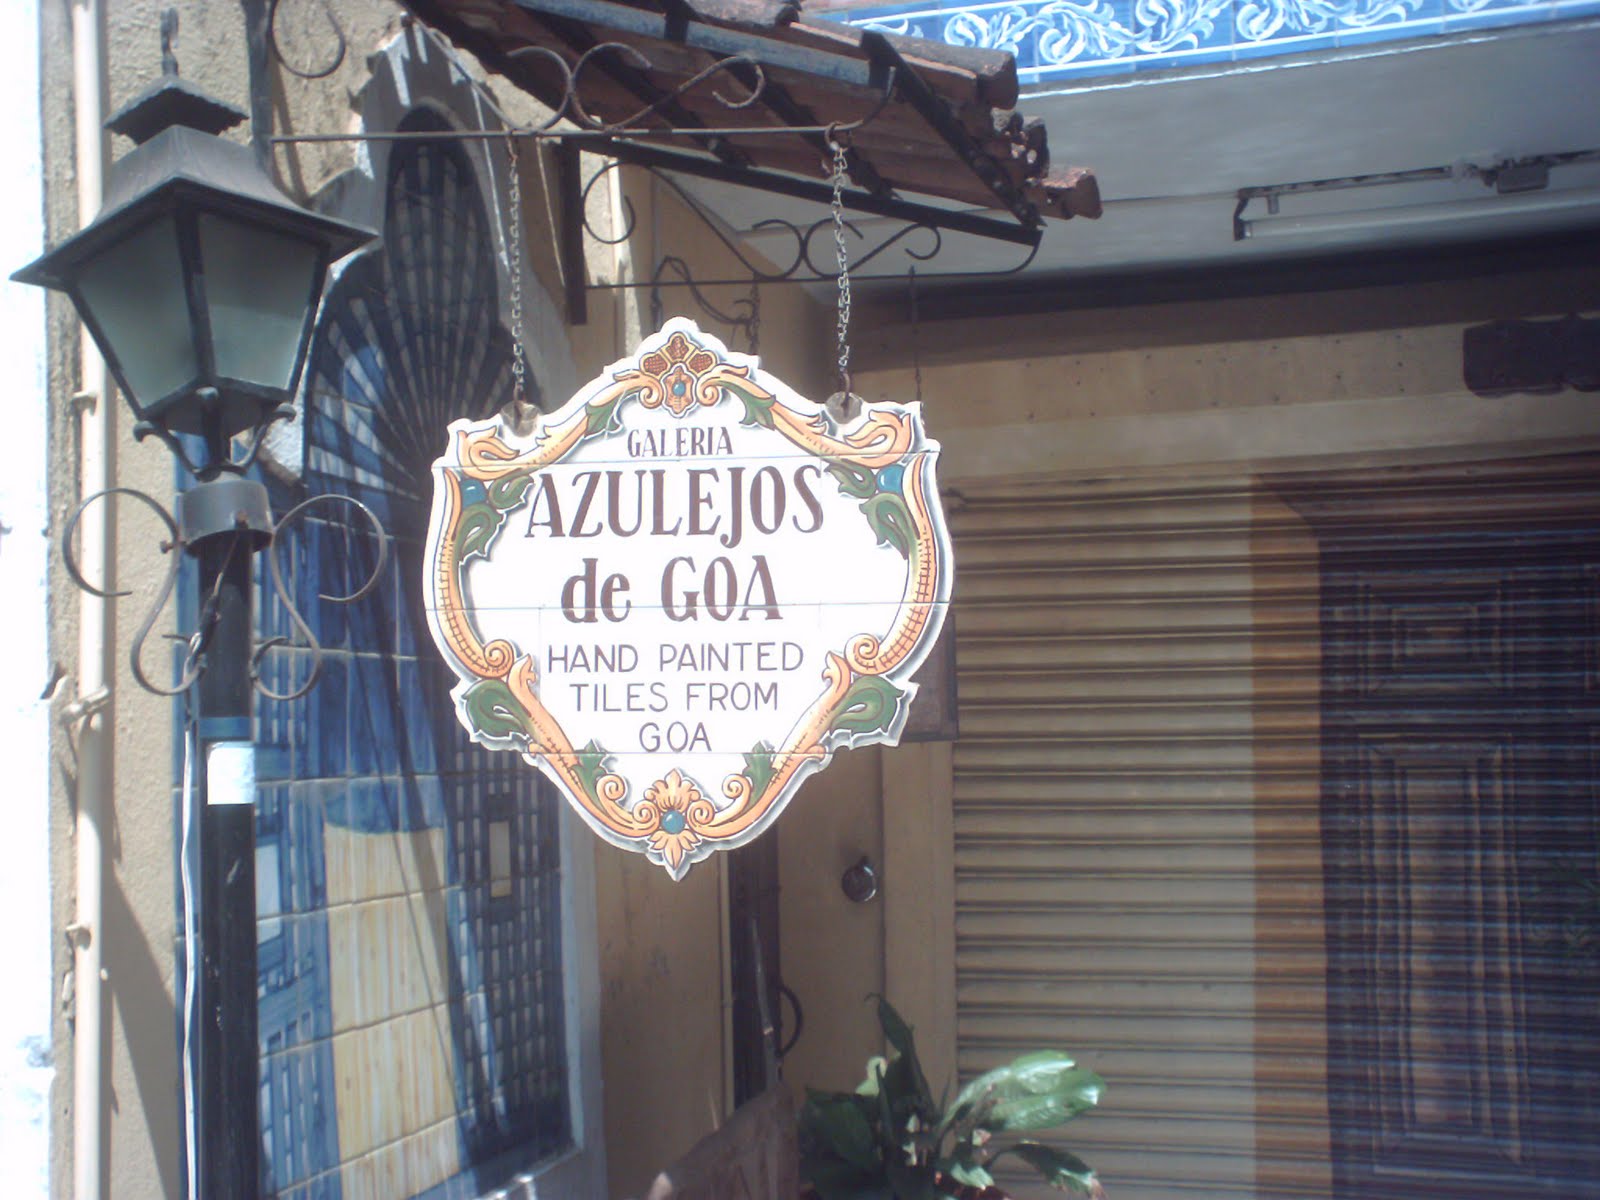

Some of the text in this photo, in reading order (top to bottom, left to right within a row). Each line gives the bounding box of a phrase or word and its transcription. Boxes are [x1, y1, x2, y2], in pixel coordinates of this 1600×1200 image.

[627, 426, 734, 458] GALERIA
[525, 464, 825, 549] AZULEJOS
[561, 555, 784, 624] de GOA
[548, 641, 804, 674] HAND PAINTED
[569, 681, 778, 713] TILES FROM
[638, 721, 712, 753] GOA
